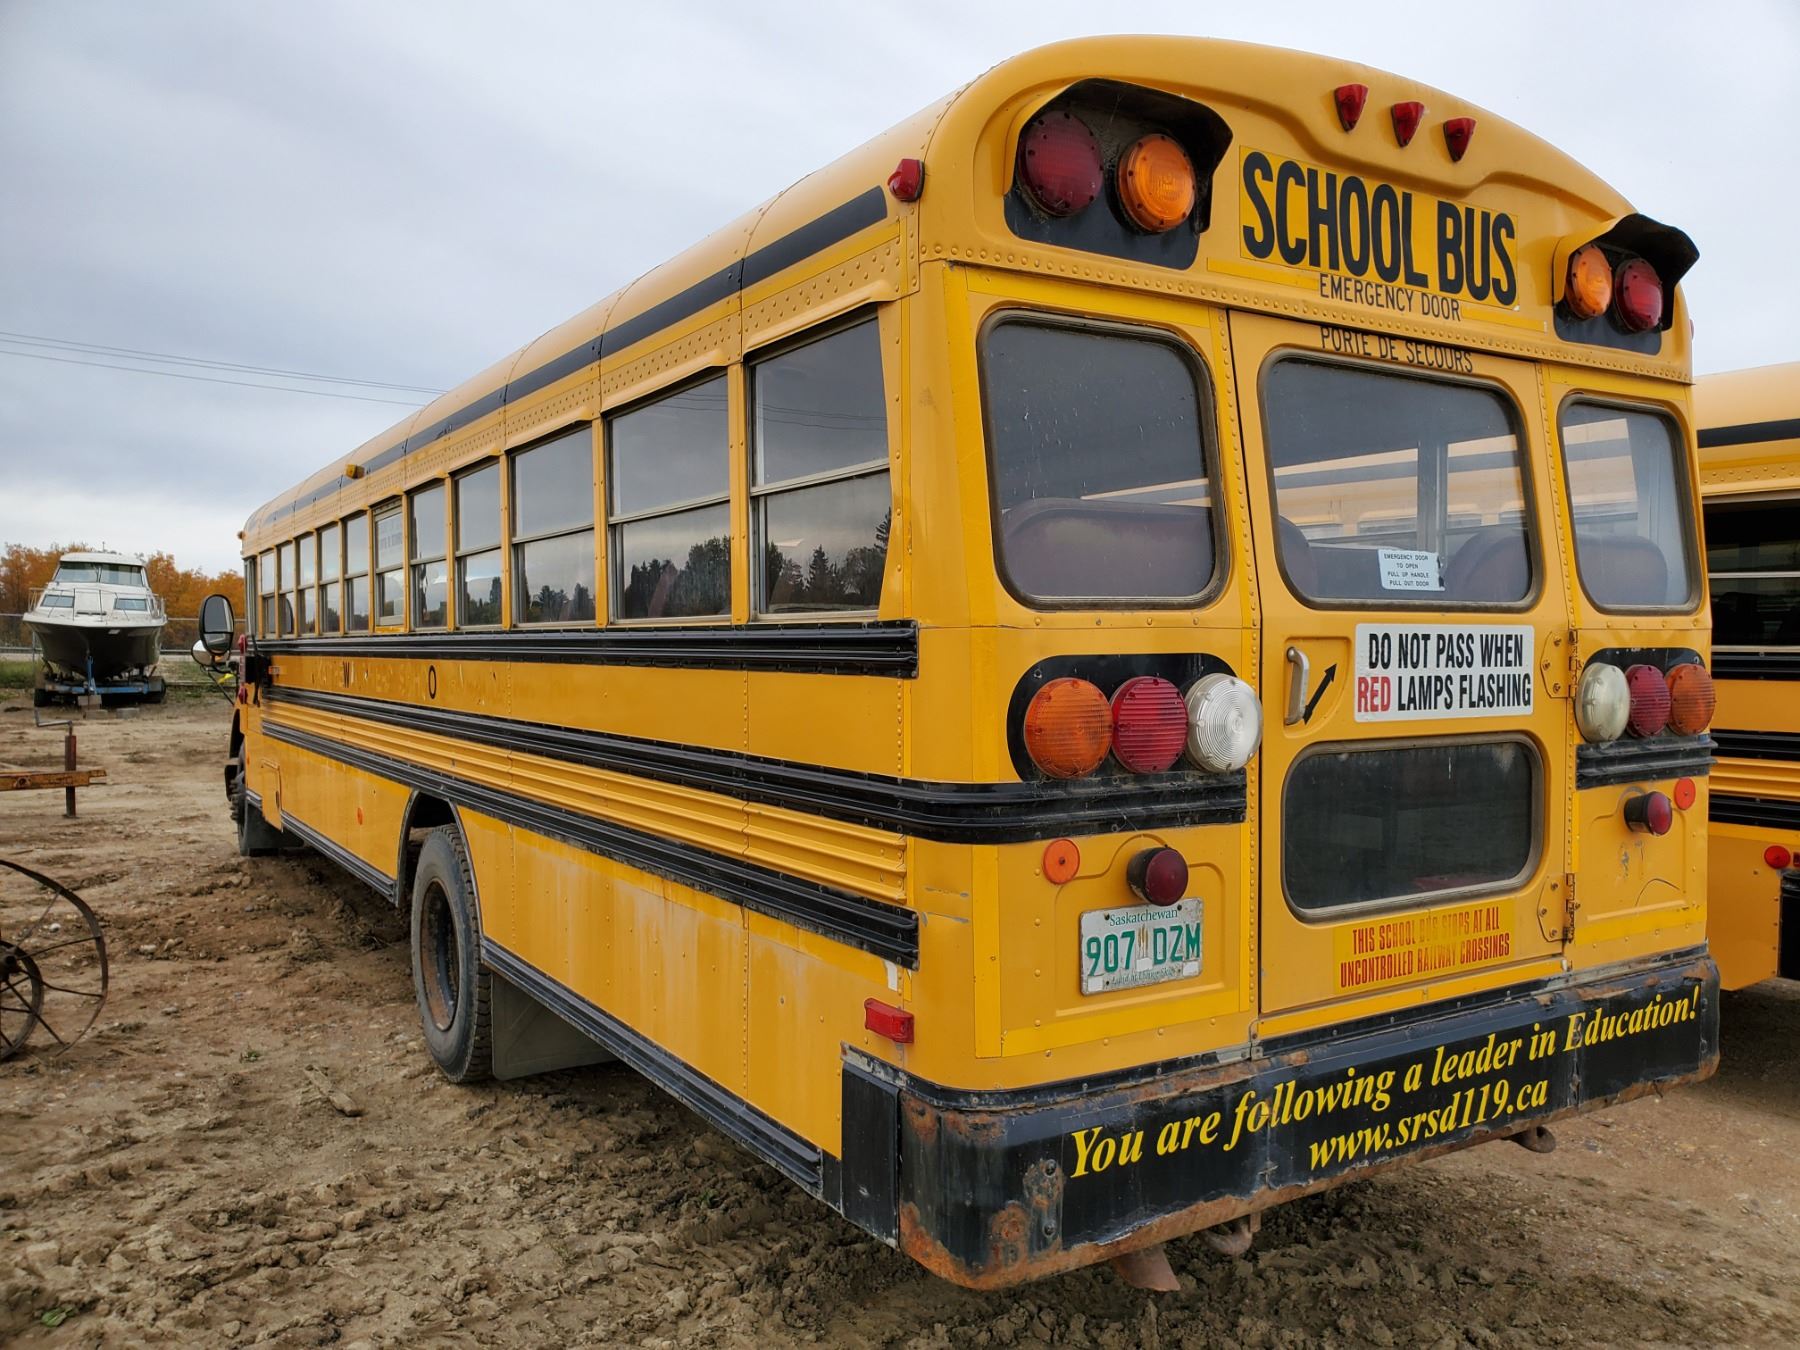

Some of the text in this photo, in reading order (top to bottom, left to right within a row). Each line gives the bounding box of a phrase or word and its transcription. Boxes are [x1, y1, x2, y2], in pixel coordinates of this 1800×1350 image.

[1243, 151, 1517, 306] SCHOOL BUS
[1320, 273, 1461, 321] EMERGENCY DOOR
[1320, 326, 1473, 373] PORTE DE SECOURS
[1368, 632, 1523, 669] DO NOT PASS WHEN
[1357, 673, 1531, 713] RED LAMPS FLASHING
[1109, 909, 1178, 926] Saskatchewan
[1352, 927, 1375, 955] THIS
[1379, 919, 1416, 950] SCHOOL
[1473, 908, 1483, 934] AT
[1485, 906, 1500, 931] ALL
[1086, 922, 1200, 977] 907 DZM
[1340, 932, 1510, 988] UNCONTROLLED RAILWAY CROSSINGS
[1069, 985, 1700, 1179] You are following a leader in Education!
[1309, 1079, 1549, 1171] www.srsd119.ca
